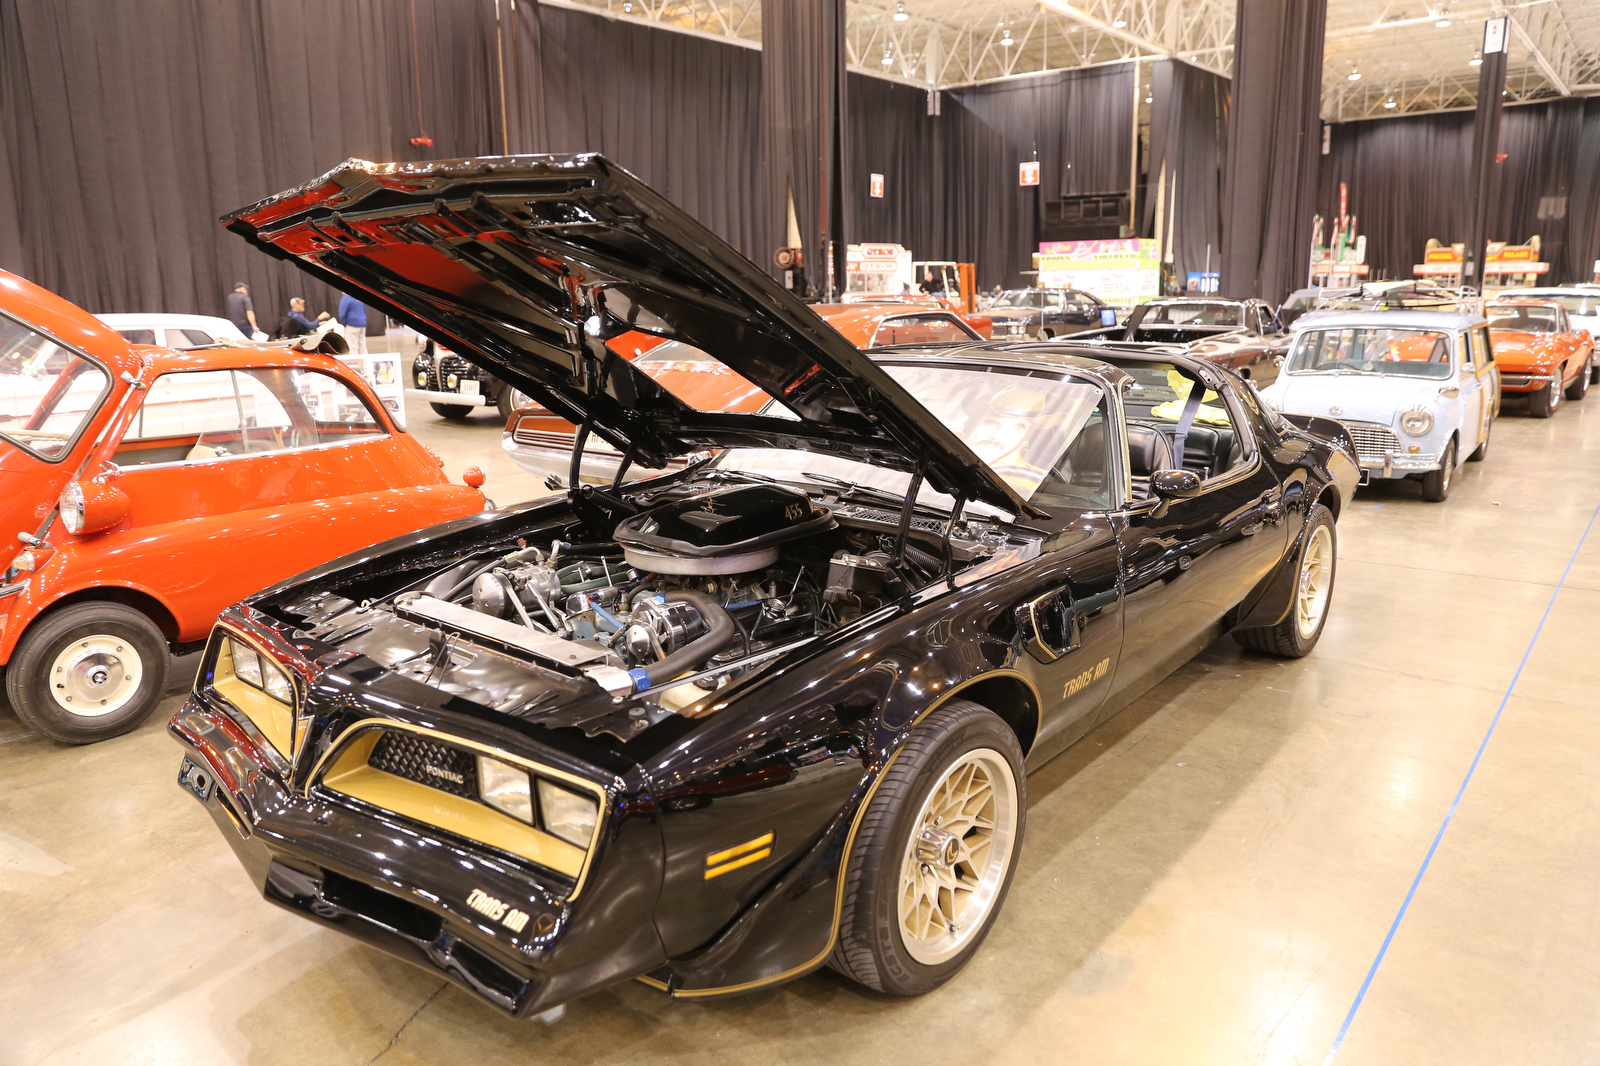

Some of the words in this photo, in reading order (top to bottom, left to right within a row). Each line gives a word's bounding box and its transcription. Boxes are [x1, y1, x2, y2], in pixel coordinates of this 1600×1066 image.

[866, 248, 894, 256] GYROS
[784, 502, 803, 520] 455
[1062, 666, 1094, 699] TRANS
[1093, 657, 1110, 681] AM
[426, 764, 464, 784] PONTIAC
[466, 888, 510, 921] TRANS
[501, 908, 530, 934] AM
